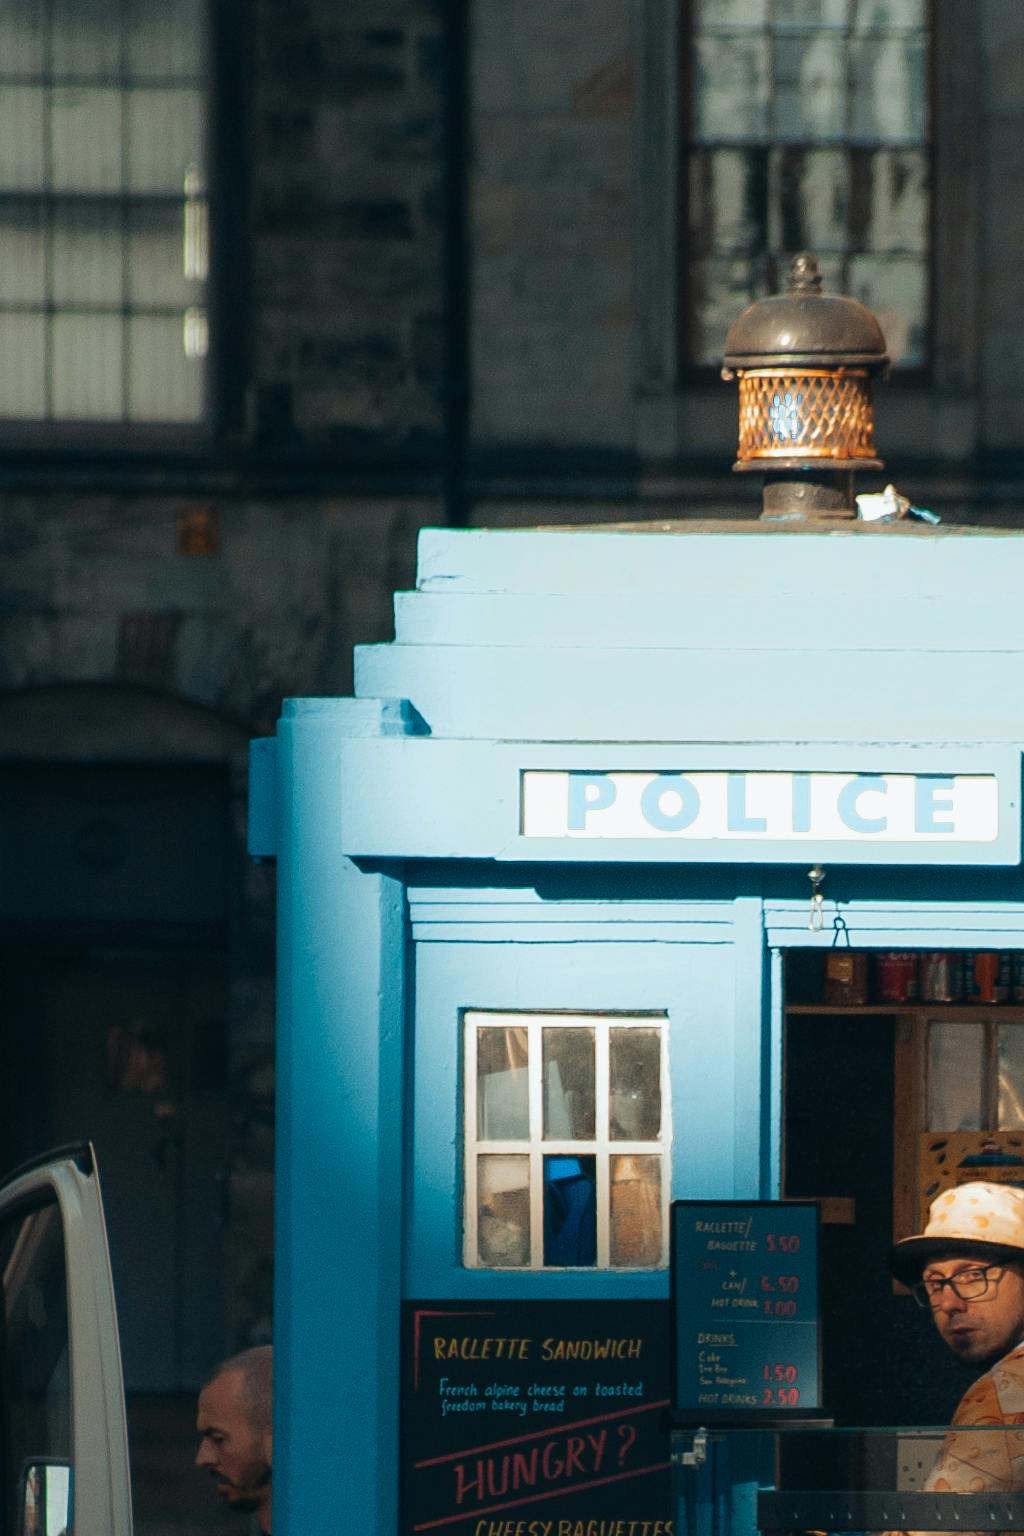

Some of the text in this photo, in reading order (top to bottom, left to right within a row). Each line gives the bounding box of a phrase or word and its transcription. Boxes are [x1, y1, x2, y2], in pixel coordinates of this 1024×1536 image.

[566, 772, 957, 835] POLICE
[434, 1337, 642, 1361] RACLETTE SANDWICH
[763, 1363, 797, 1384] 1.50
[439, 1378, 477, 1397] French
[484, 1382, 520, 1400] alpine
[527, 1381, 566, 1397] cheese
[595, 1381, 644, 1397] toasted
[441, 1400, 565, 1417] freedom bakery bread
